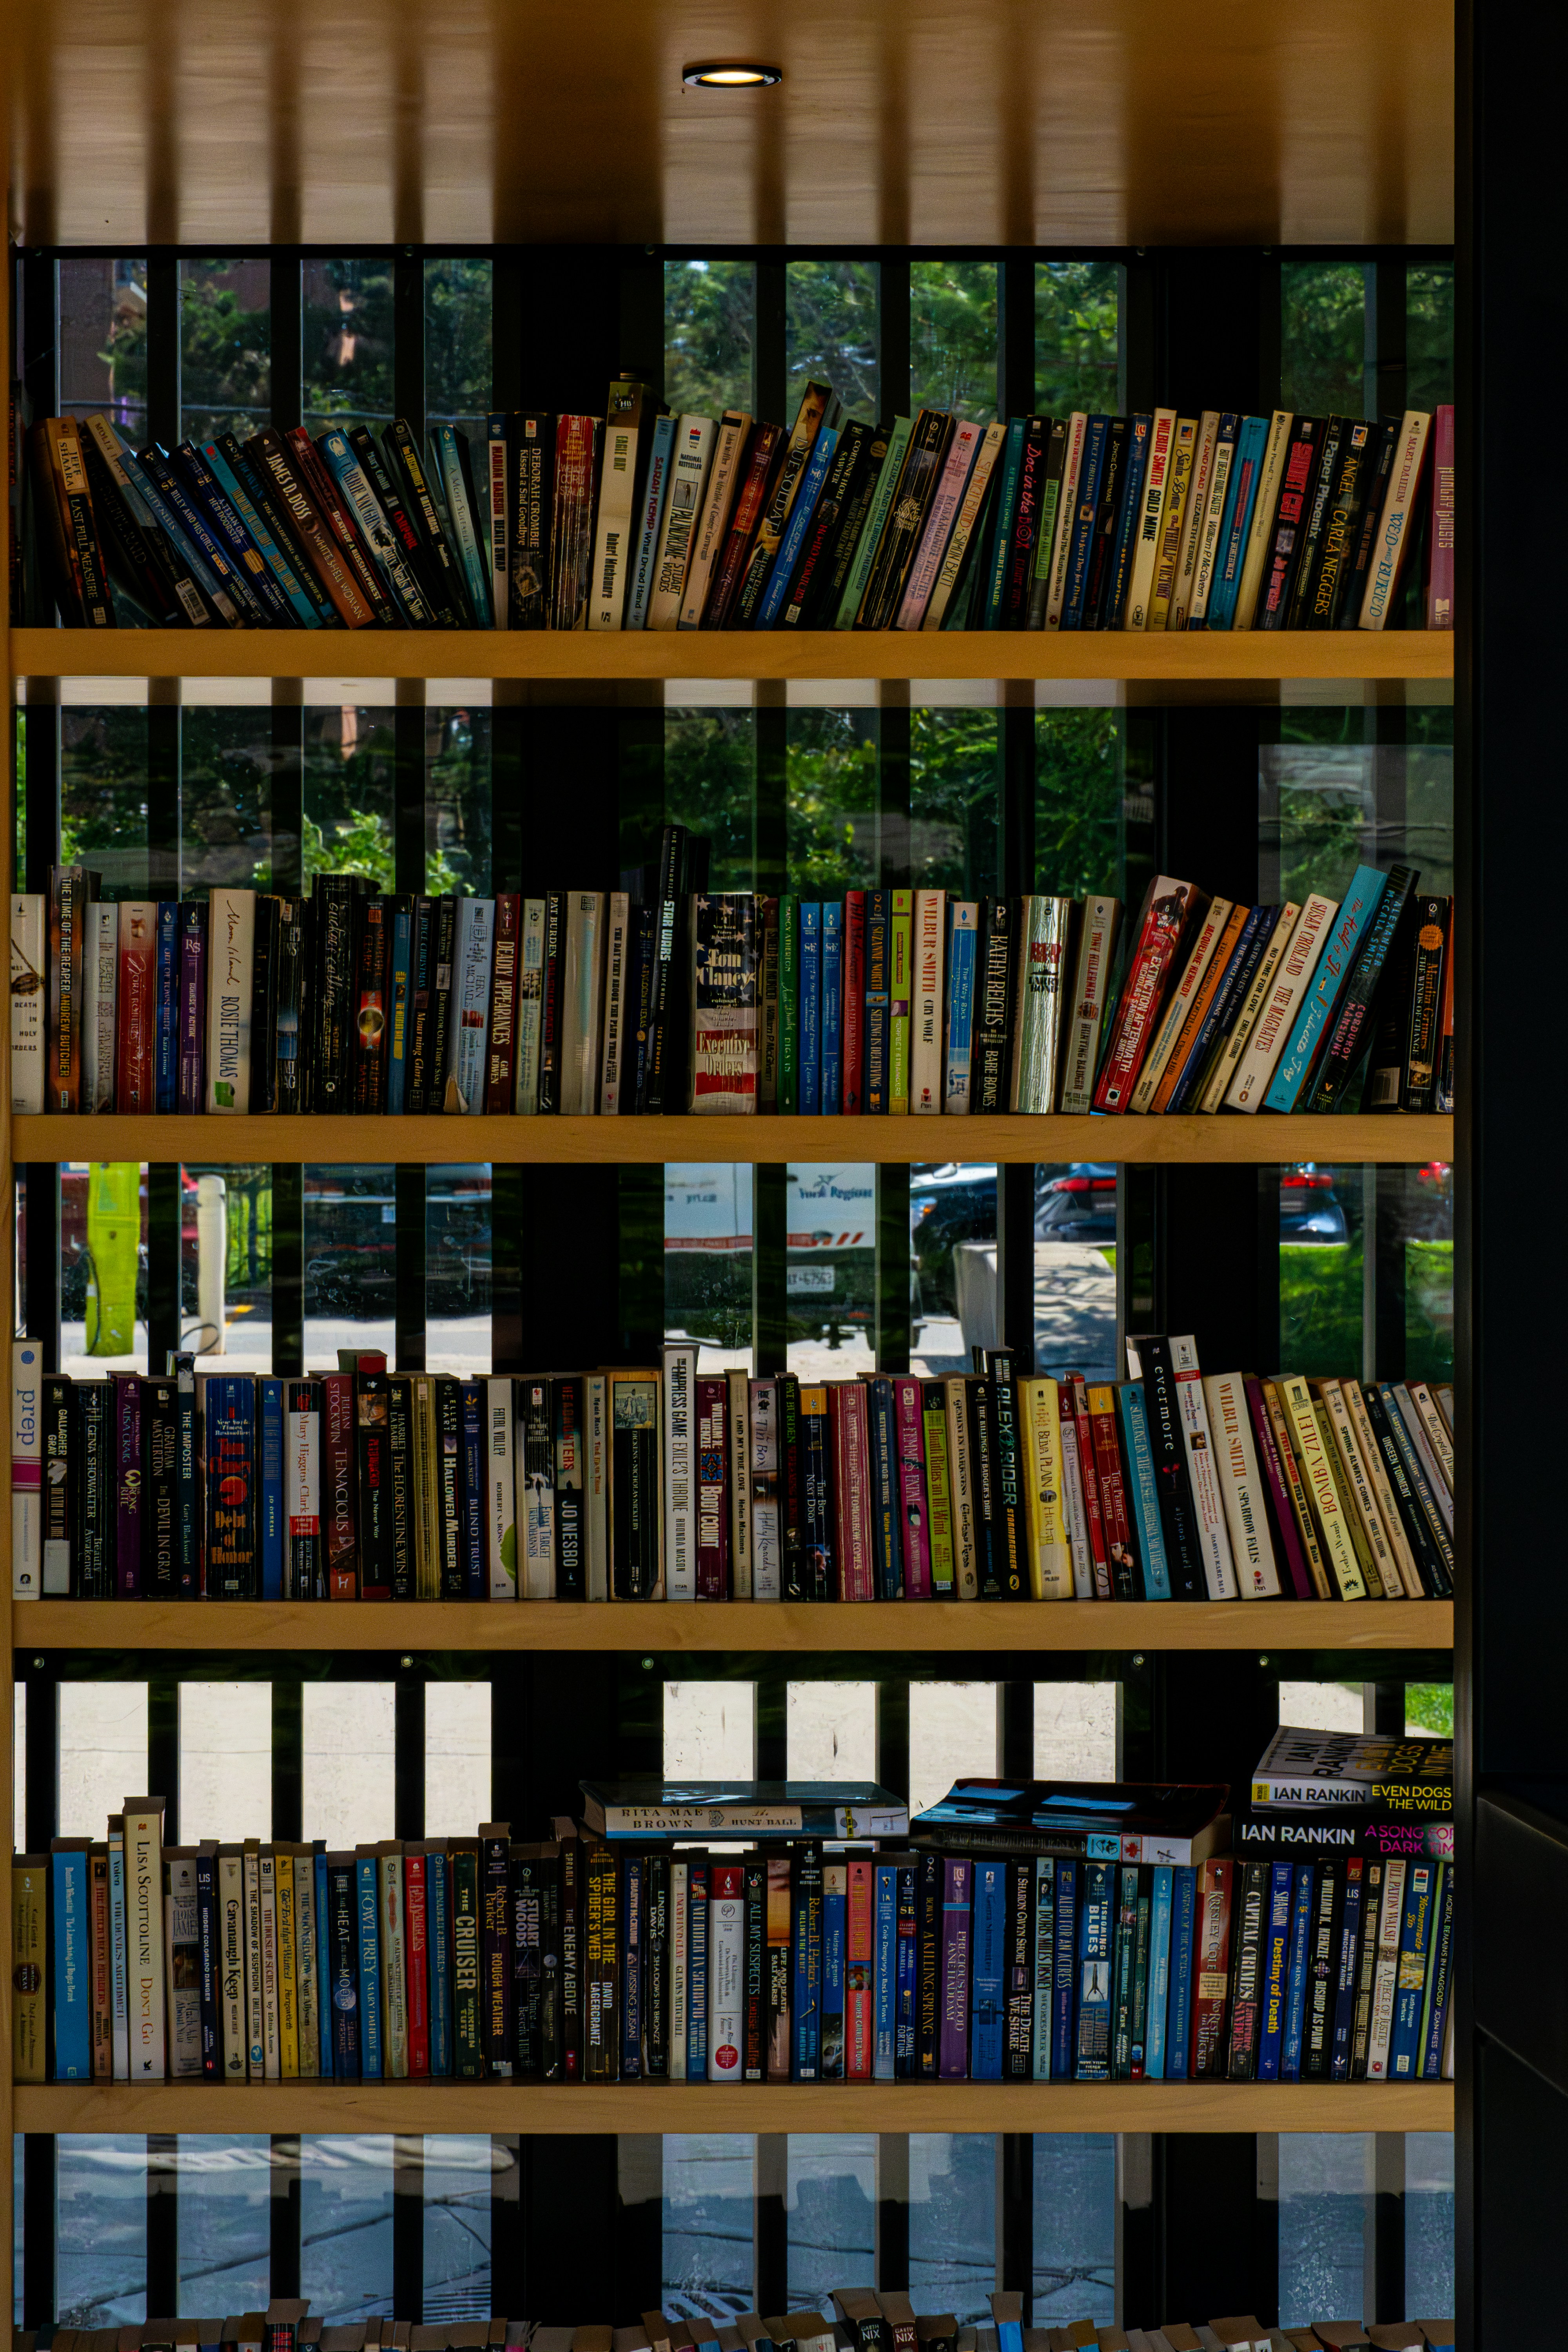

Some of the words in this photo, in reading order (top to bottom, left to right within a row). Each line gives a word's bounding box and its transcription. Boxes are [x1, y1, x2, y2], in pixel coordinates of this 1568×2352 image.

[1154, 418, 1171, 454] WILBUR
[60, 442, 73, 487] SHAARA
[519, 449, 529, 477] Kissed
[531, 448, 541, 497] DEBORAH
[651, 457, 664, 495] SARAH
[1151, 455, 1165, 485] SMITH
[1321, 441, 1338, 482] Paper
[1339, 456, 1357, 495] ANGEL
[265, 454, 292, 485] JAMES
[288, 496, 311, 520] DOSS
[519, 488, 528, 505] Sad
[1147, 489, 1161, 513] GOLD
[71, 499, 83, 523] LAST
[517, 507, 528, 546] Goodbye
[530, 501, 540, 548] CROMBIE
[646, 497, 658, 530] KEMP
[1308, 484, 1330, 539] Phoenix
[75, 526, 89, 548] FULL
[642, 532, 652, 555] What
[664, 510, 693, 560] PALINDROME
[1143, 515, 1157, 541] MINE
[1327, 510, 1347, 553] CARLA
[82, 552, 98, 599] MEASURE
[639, 557, 649, 583] Dread
[660, 562, 672, 593] WOODS
[670, 564, 684, 596] STUART
[1314, 556, 1338, 615] NEGGERS
[635, 585, 646, 608] Hand
[61, 878, 71, 895] THE
[61, 897, 71, 919] TIME
[550, 897, 558, 914] PAT
[662, 900, 675, 926] STAR
[1307, 902, 1328, 932] SUSAN
[61, 921, 71, 934] OF
[548, 917, 557, 958] BURDEN
[924, 898, 938, 948] WILBUR
[61, 936, 71, 954] THE
[497, 941, 515, 976] DEADLY
[661, 929, 673, 961] WARS
[989, 935, 1008, 978] KATHY
[1269, 947, 1279, 958] NO
[1286, 931, 1318, 976] CROSLAND
[60, 956, 71, 991] REAPER
[922, 953, 936, 992] SMITH
[1134, 955, 1162, 1013] EXTINCTION
[1262, 959, 1275, 977] TIME
[1256, 978, 1268, 993] FOR
[1276, 985, 1294, 1004] THE
[60, 994, 71, 1032] ANDREW
[220, 996, 240, 1028] ROSIE
[492, 980, 511, 1044] APPEARANCES
[924, 999, 933, 1015] CRY
[985, 981, 1006, 1025] REICHS
[1247, 994, 1262, 1014] LOVE
[922, 1019, 933, 1044] WOLF
[1120, 1013, 1145, 1073] AFTERMATH
[1255, 1005, 1287, 1054] MAGNATES
[60, 1034, 71, 1076] BUTCHER
[220, 1030, 239, 1077] THOMAS
[491, 1055, 500, 1083] BOWEN
[500, 1061, 509, 1078] GAIL
[984, 1051, 998, 1074] BARE
[983, 1076, 998, 1106] BONES
[672, 1366, 686, 1408] EMPRESS
[18, 1389, 37, 1446] prep
[182, 1411, 191, 1428] THE
[997, 1387, 1014, 1434] ALEX
[1154, 1366, 1176, 1451] evermore
[1219, 1382, 1240, 1433] WILBUR
[58, 1409, 67, 1455] GALLAGHER
[672, 1411, 686, 1437] GAME
[48, 1435, 57, 1455] GRAY
[152, 1419, 163, 1476] MASTERTON
[163, 1426, 175, 1468] GRAHAM
[182, 1432, 191, 1479] IMPOSTER
[672, 1443, 688, 1474] EXILE'S
[1227, 1438, 1246, 1478] SMITH
[335, 1448, 348, 1531] TENACIOUS
[444, 1458, 456, 1517] HALLOWED
[1000, 1452, 1016, 1504] RIDER
[562, 1501, 577, 1518] JO
[673, 1478, 688, 1512] THRONE
[157, 1498, 169, 1533] DEVIL
[1239, 1492, 1256, 1534] SPARROW
[158, 1535, 169, 1548] IN
[446, 1519, 457, 1568] MURDER
[563, 1523, 577, 1567] NESBO
[1245, 1537, 1260, 1563] FALLS
[158, 1551, 170, 1581] GRAY
[1274, 1788, 1304, 1802] IAN
[1306, 1788, 1366, 1803] RANKIN
[1372, 1785, 1411, 1797] EVEN
[1413, 1785, 1452, 1798] DOGS
[1387, 1798, 1411, 1809] THE
[1414, 1798, 1452, 1811] WILD
[622, 1808, 660, 1817] RITA
[670, 1808, 704, 1817] MAE
[632, 1819, 693, 1829] BROWN
[1242, 1824, 1278, 1841] IAN
[1281, 1826, 1355, 1845] RANKIN
[1365, 1826, 1376, 1836] A
[1377, 1825, 1425, 1838] SONG
[1380, 1840, 1425, 1853] DARK
[137, 1842, 151, 1871] LISA
[250, 1889, 258, 1904] THE
[603, 1873, 615, 1895] THE
[565, 1909, 574, 1924] THE
[588, 1877, 601, 1929] SPIDER'S
[603, 1898, 616, 1924] GIRL
[749, 1902, 760, 1922] ALL
[138, 1876, 152, 1965] SCOTTOLINE
[227, 1900, 240, 1965] Cavanaugh
[250, 1906, 259, 1938] SHADOW
[515, 1898, 528, 1948] WOODS
[528, 1900, 539, 1947] STUART
[603, 1928, 616, 1938] IN
[749, 1925, 760, 1940] MY
[1087, 1906, 1100, 1953] BLUES
[251, 1941, 259, 1950] OF
[456, 1916, 476, 1990] CRUISER
[564, 1926, 576, 1969] ENEMY
[589, 1934, 601, 1960] WEB
[603, 1941, 616, 1964] THE
[1271, 1938, 1284, 1982] Destiny
[224, 1969, 240, 1999] Keep
[251, 1952, 260, 1992] SUSPICION
[491, 1953, 502, 1987] ROUGH
[749, 1944, 760, 1994] SUSPECTS
[564, 1973, 576, 2014] ABOVE
[603, 1982, 612, 2009] DAVID
[1270, 1984, 1281, 1996] of
[1314, 1981, 1326, 2011] BISHOP
[492, 1990, 504, 2035] WEATHER
[590, 1982, 601, 2046] LAGERCRANTZ
[1268, 1999, 1281, 2033] Death
[1312, 2014, 1324, 2025] AS
[1310, 2026, 1323, 2049] PAWN
[861, 2329, 880, 2341] NIX
[895, 2333, 915, 2342] NIX
